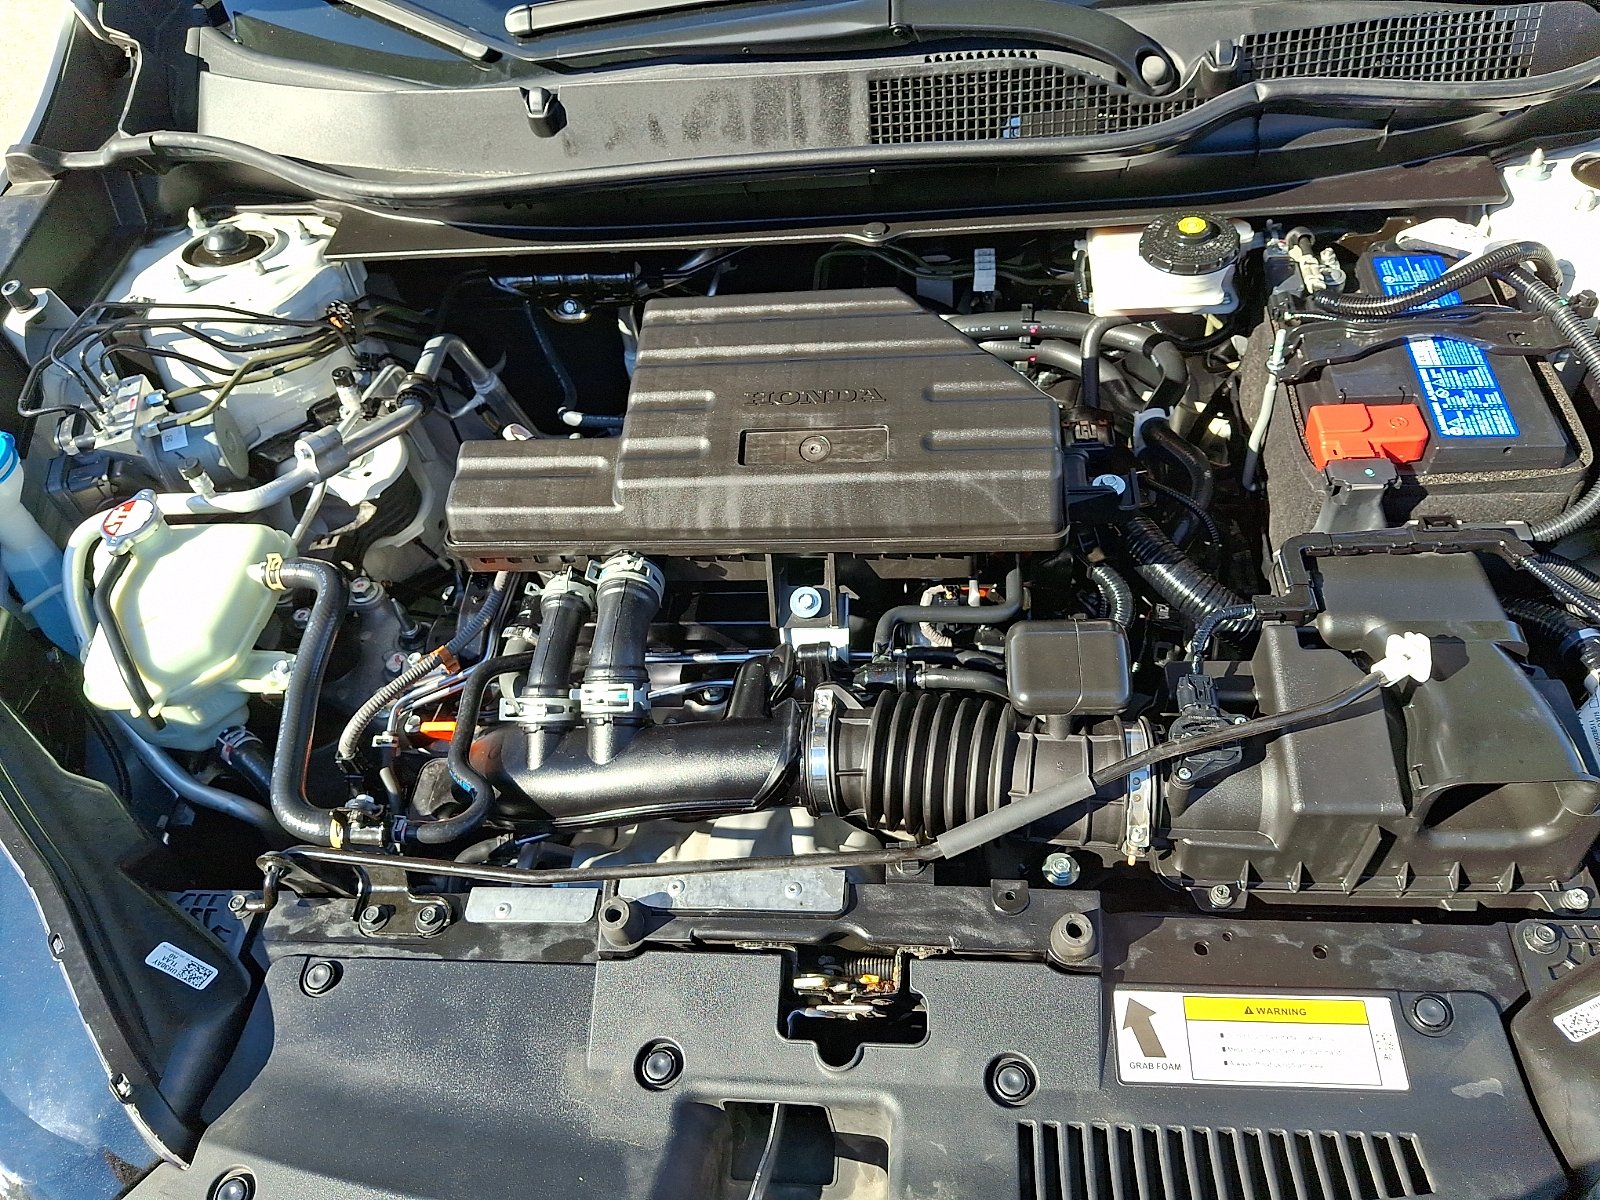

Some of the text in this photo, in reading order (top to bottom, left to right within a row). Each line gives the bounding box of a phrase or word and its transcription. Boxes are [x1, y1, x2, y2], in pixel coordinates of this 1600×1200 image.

[743, 388, 888, 406] HONDA
[1256, 1007, 1307, 1016] WARNING
[1129, 1062, 1182, 1071] GRAB FOAM
